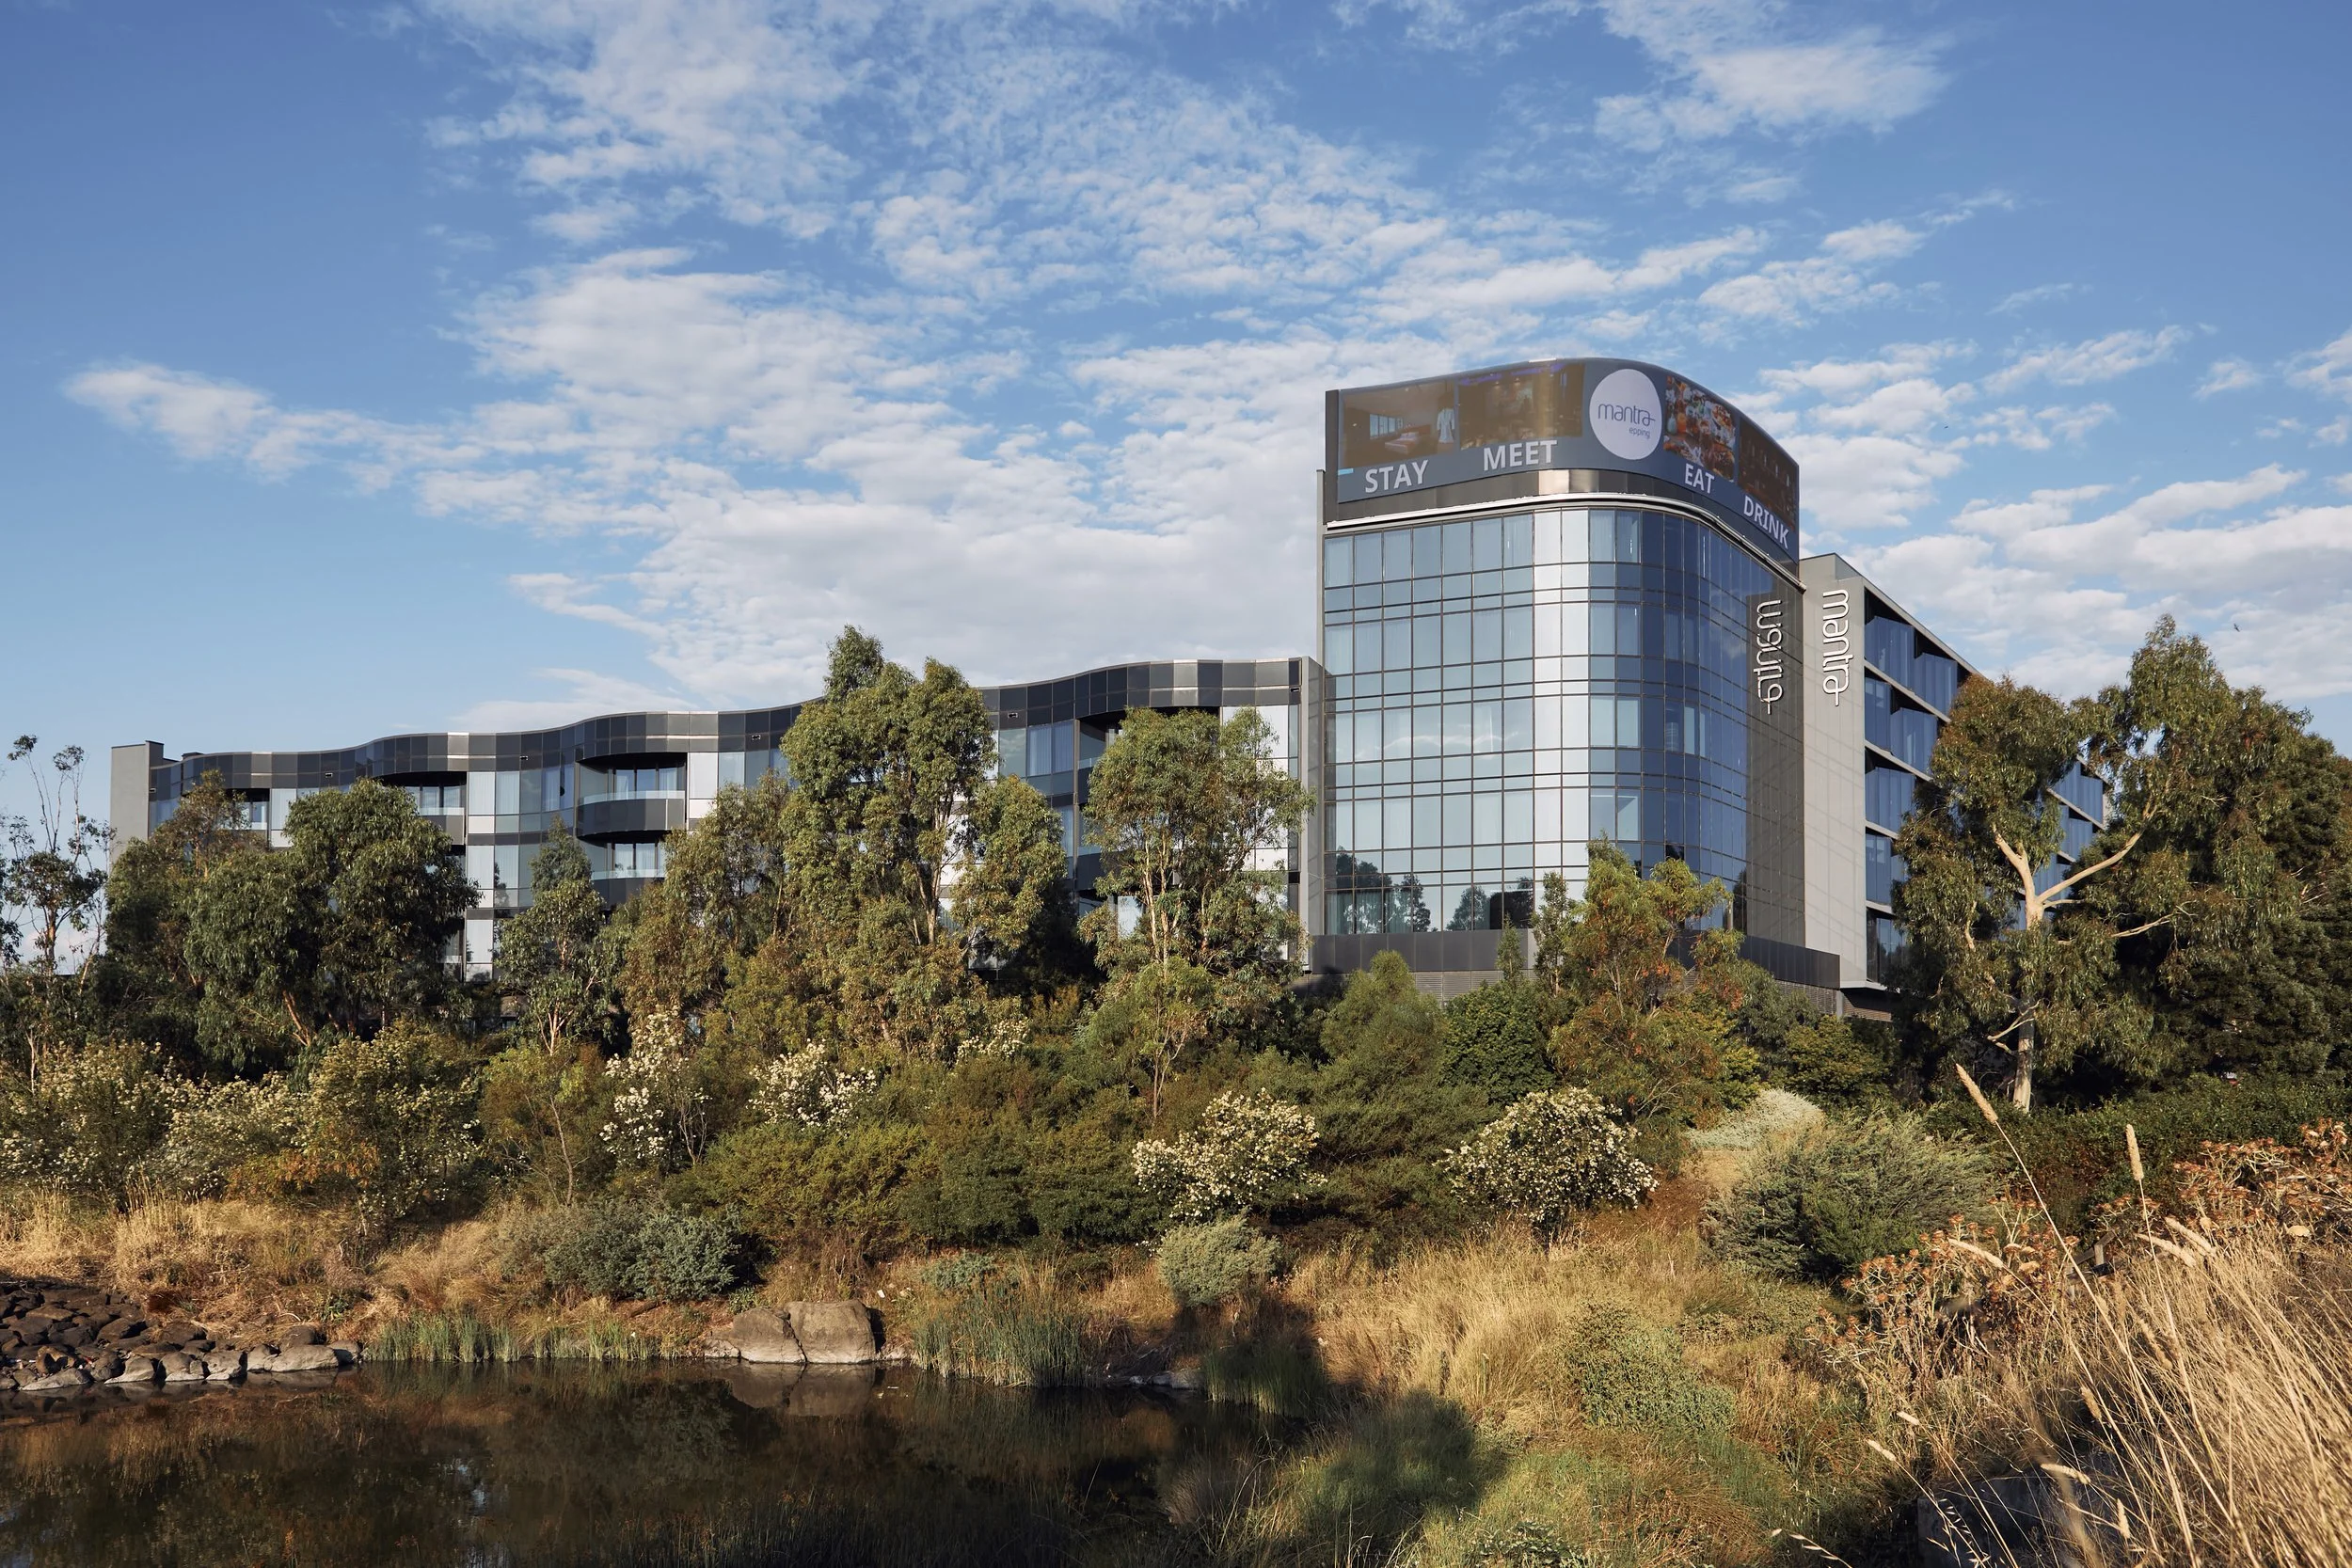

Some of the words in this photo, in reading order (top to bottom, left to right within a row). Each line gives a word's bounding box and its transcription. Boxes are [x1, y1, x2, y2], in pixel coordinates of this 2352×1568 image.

[1597, 404, 1656, 427] mantra
[1629, 427, 1651, 439] epping
[1484, 439, 1558, 471] MEET
[1365, 459, 1429, 493] STAY
[1685, 463, 1715, 494] EAT
[1743, 495, 1789, 549] DRINK
[1822, 589, 1854, 706] mantra
